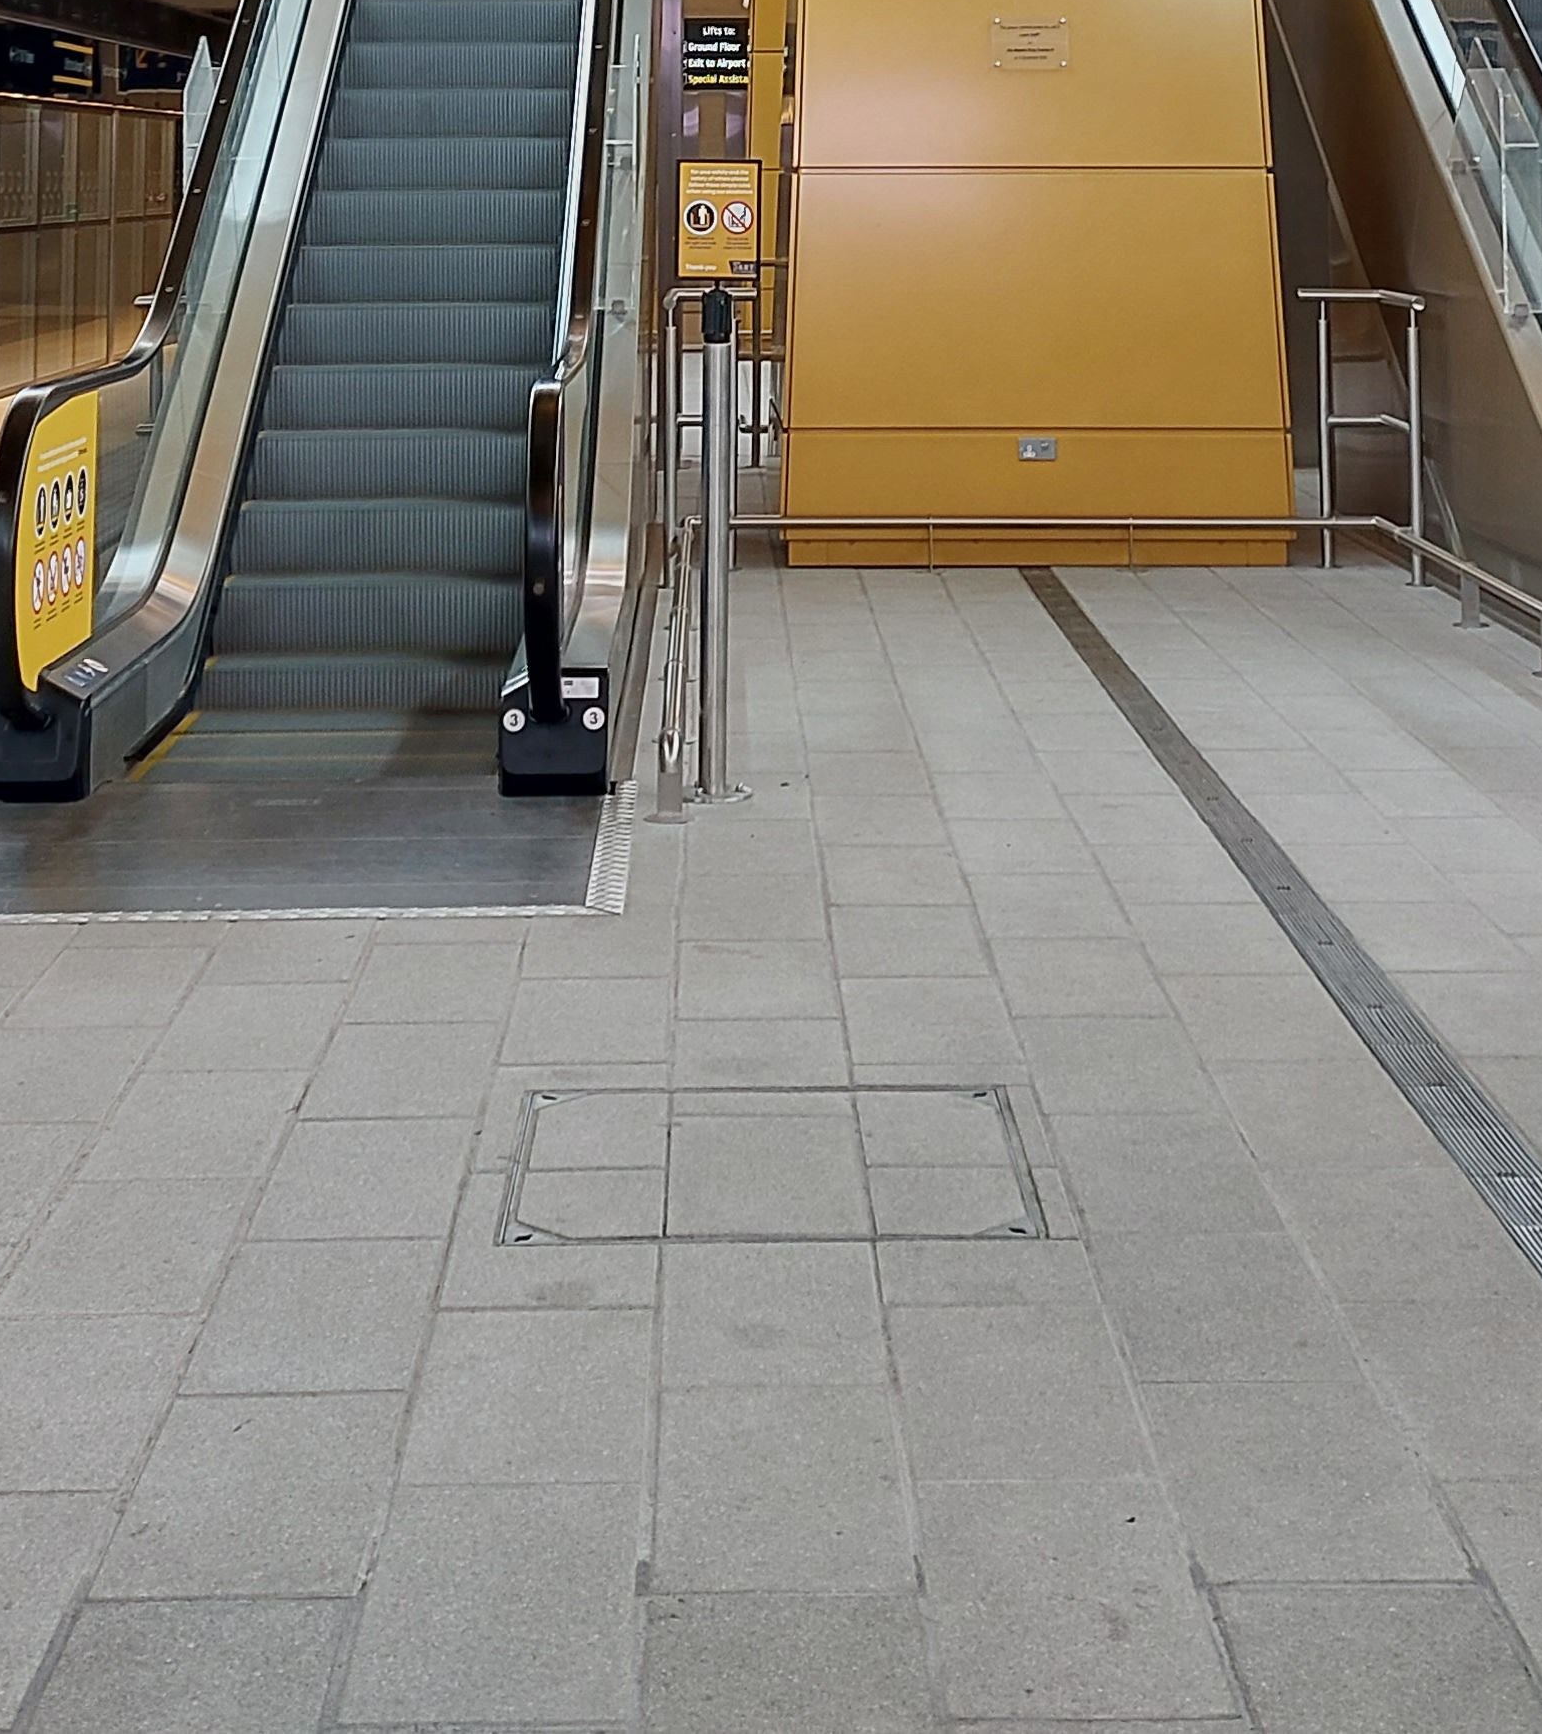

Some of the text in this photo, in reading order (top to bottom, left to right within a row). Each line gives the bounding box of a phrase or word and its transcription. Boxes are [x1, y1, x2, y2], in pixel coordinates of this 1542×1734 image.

[702, 26, 722, 36] Lifts
[688, 42, 741, 53] Ground Floor
[688, 58, 747, 69] Exit to Airport
[688, 73, 717, 85] Special
[509, 713, 519, 727] 3
[589, 711, 598, 725] 3
